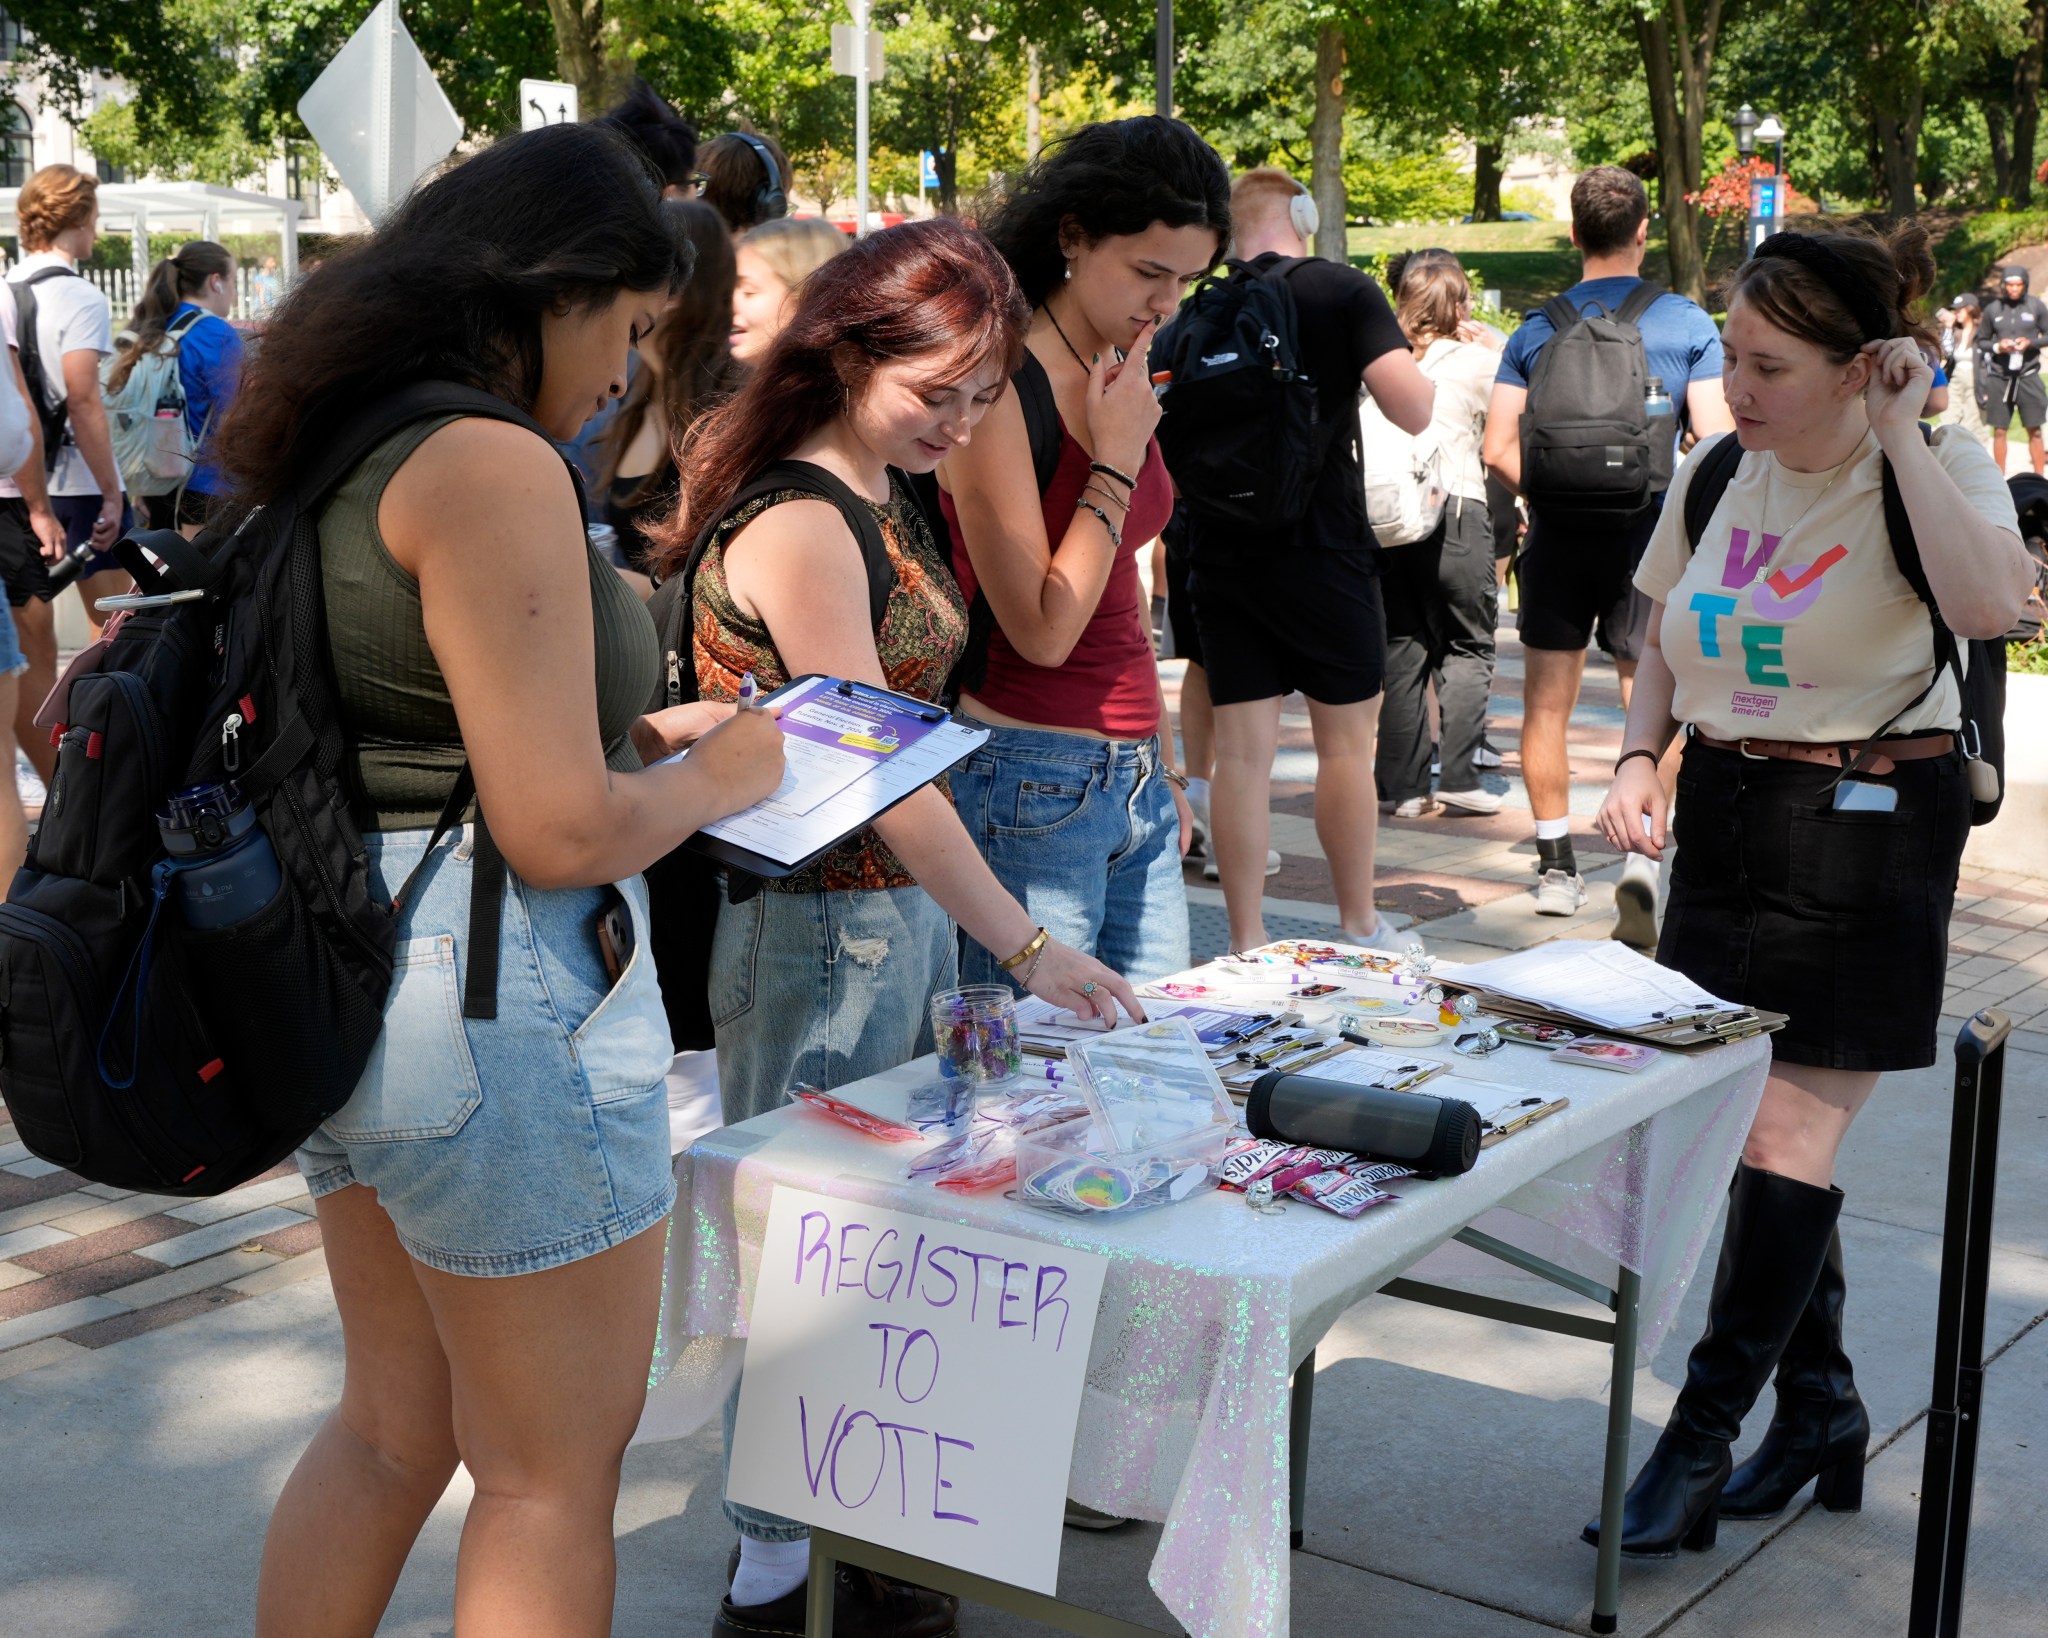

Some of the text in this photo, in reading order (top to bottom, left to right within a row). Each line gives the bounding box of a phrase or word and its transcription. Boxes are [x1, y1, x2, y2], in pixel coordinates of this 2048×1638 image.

[809, 708, 836, 718] General
[1731, 705, 1770, 718] america
[1735, 694, 1774, 708] nextgen
[1326, 1180, 1381, 1208] Welch's
[794, 1210, 1070, 1352] REGISTER
[868, 1323, 939, 1403] TO
[799, 1395, 979, 1525] VOTE
